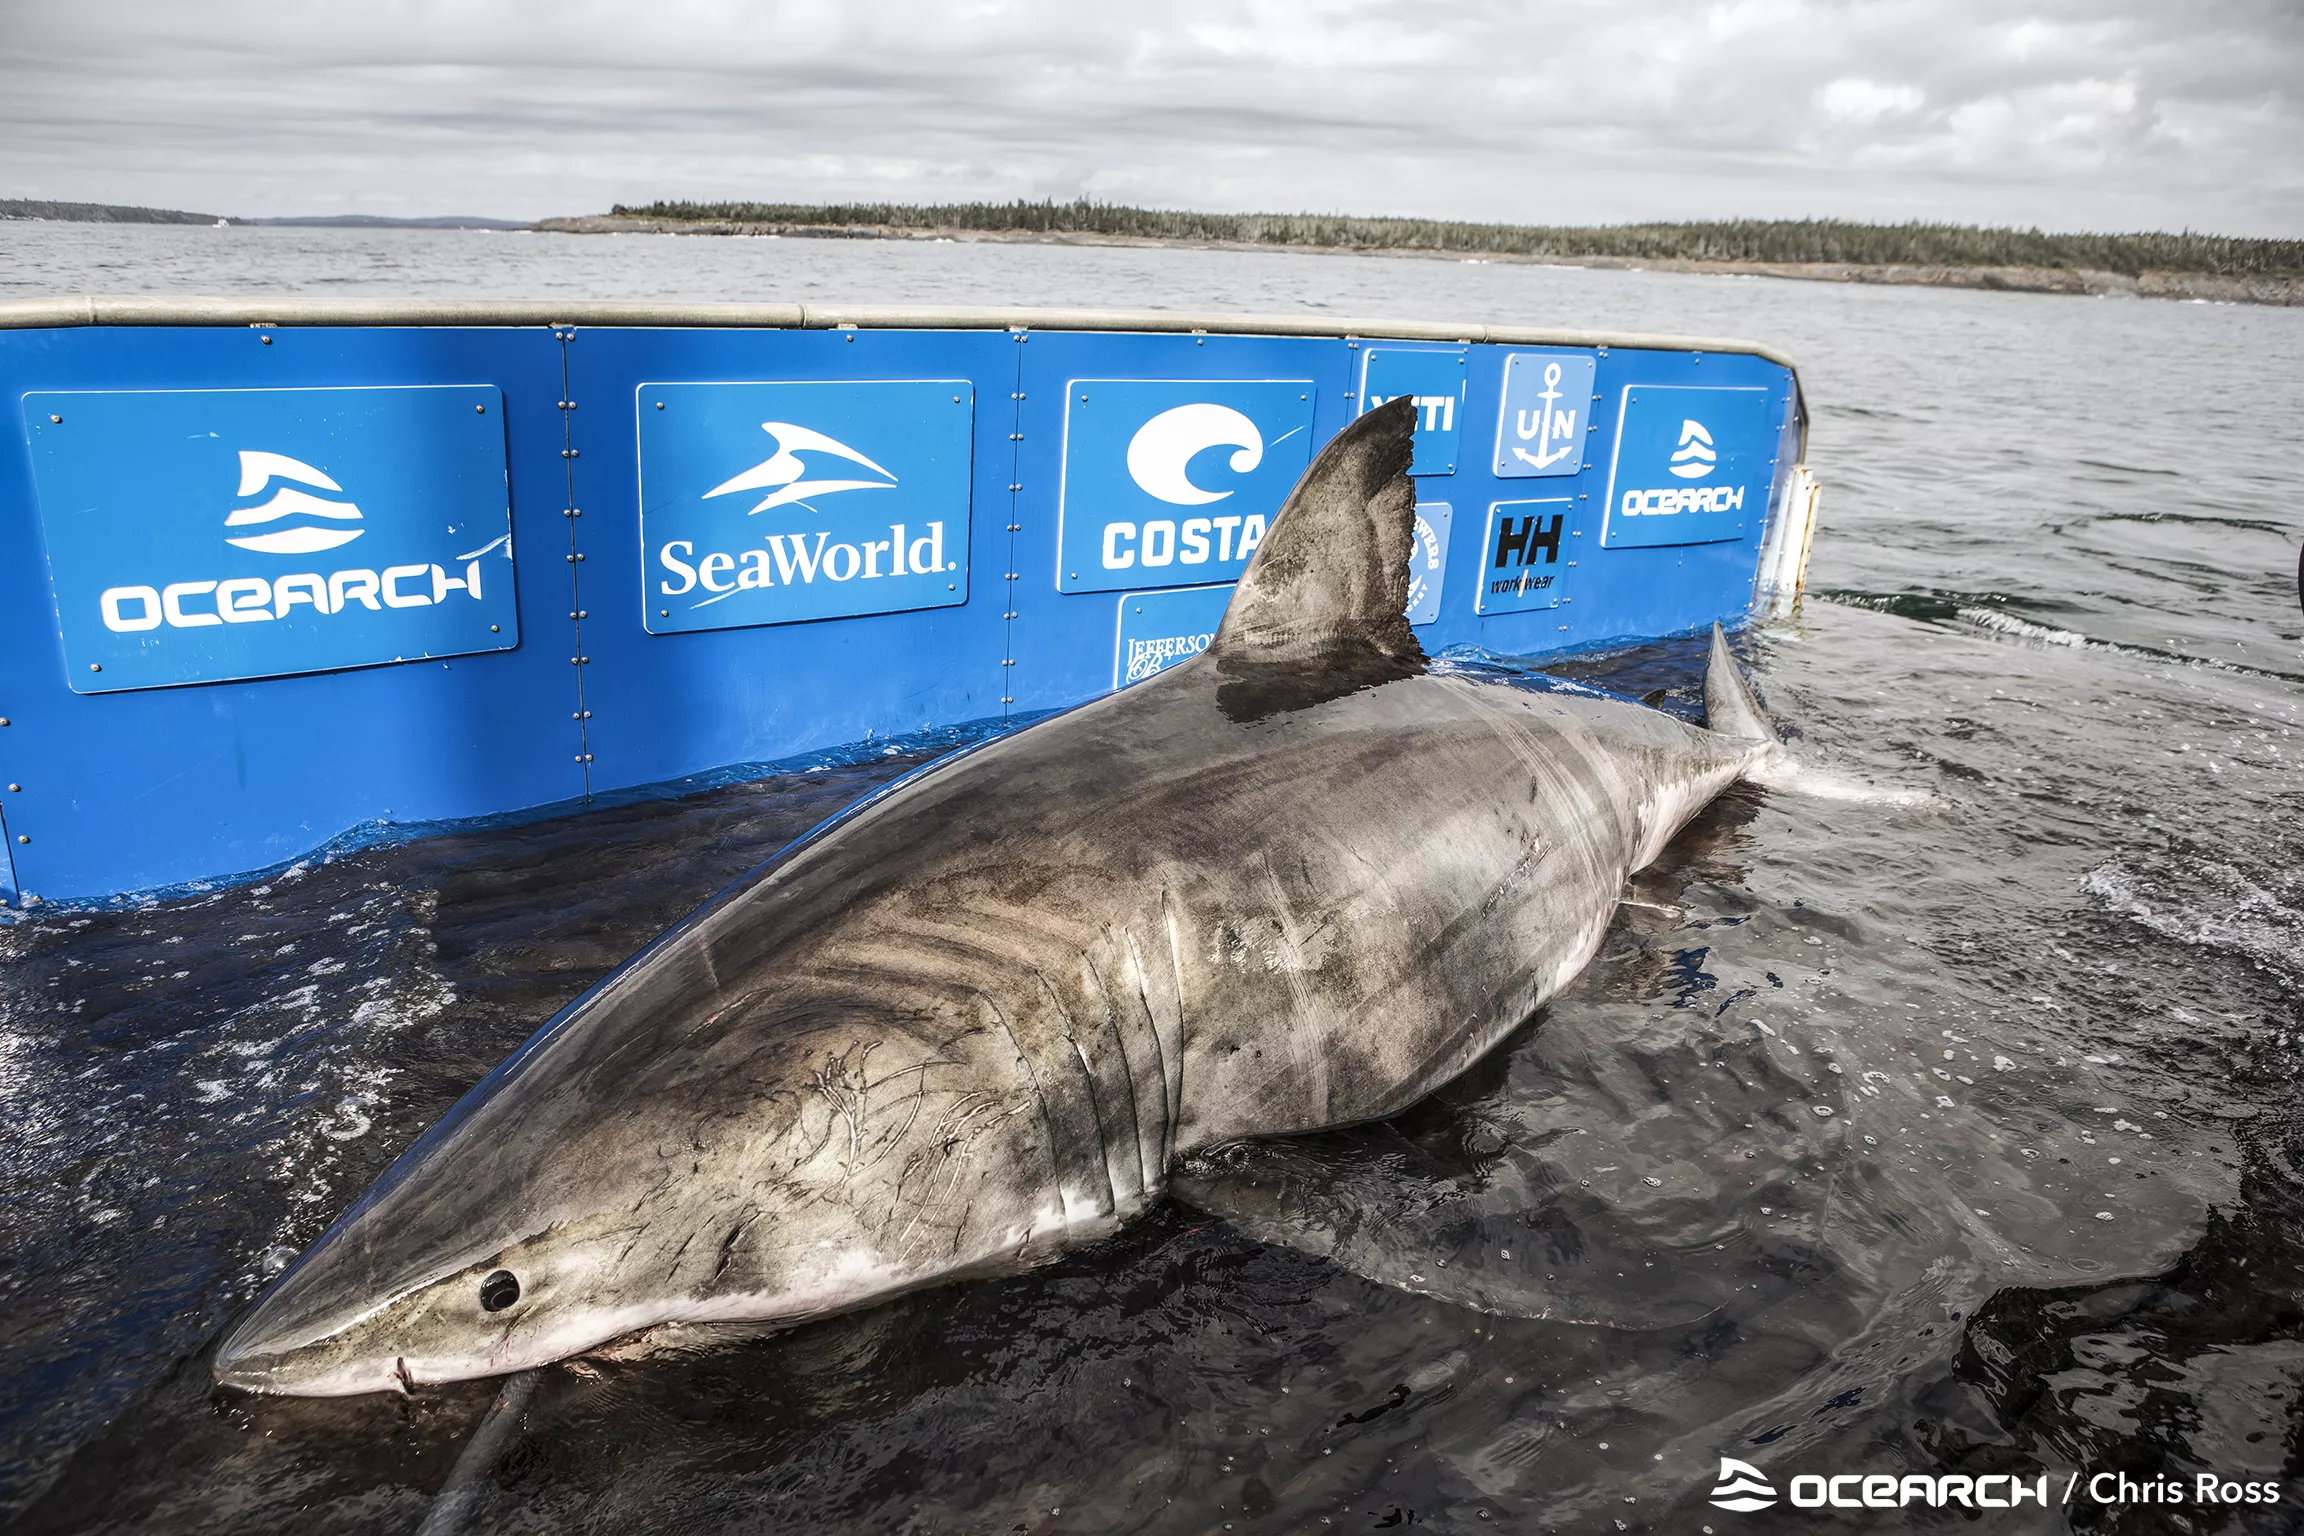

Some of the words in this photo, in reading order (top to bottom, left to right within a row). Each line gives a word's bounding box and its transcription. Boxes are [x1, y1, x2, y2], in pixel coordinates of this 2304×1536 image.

[1621, 485, 1745, 516] OCEARCH
[1102, 514, 1267, 570] COSTA
[1495, 514, 1564, 569] HH
[100, 559, 482, 633] OCEARCH
